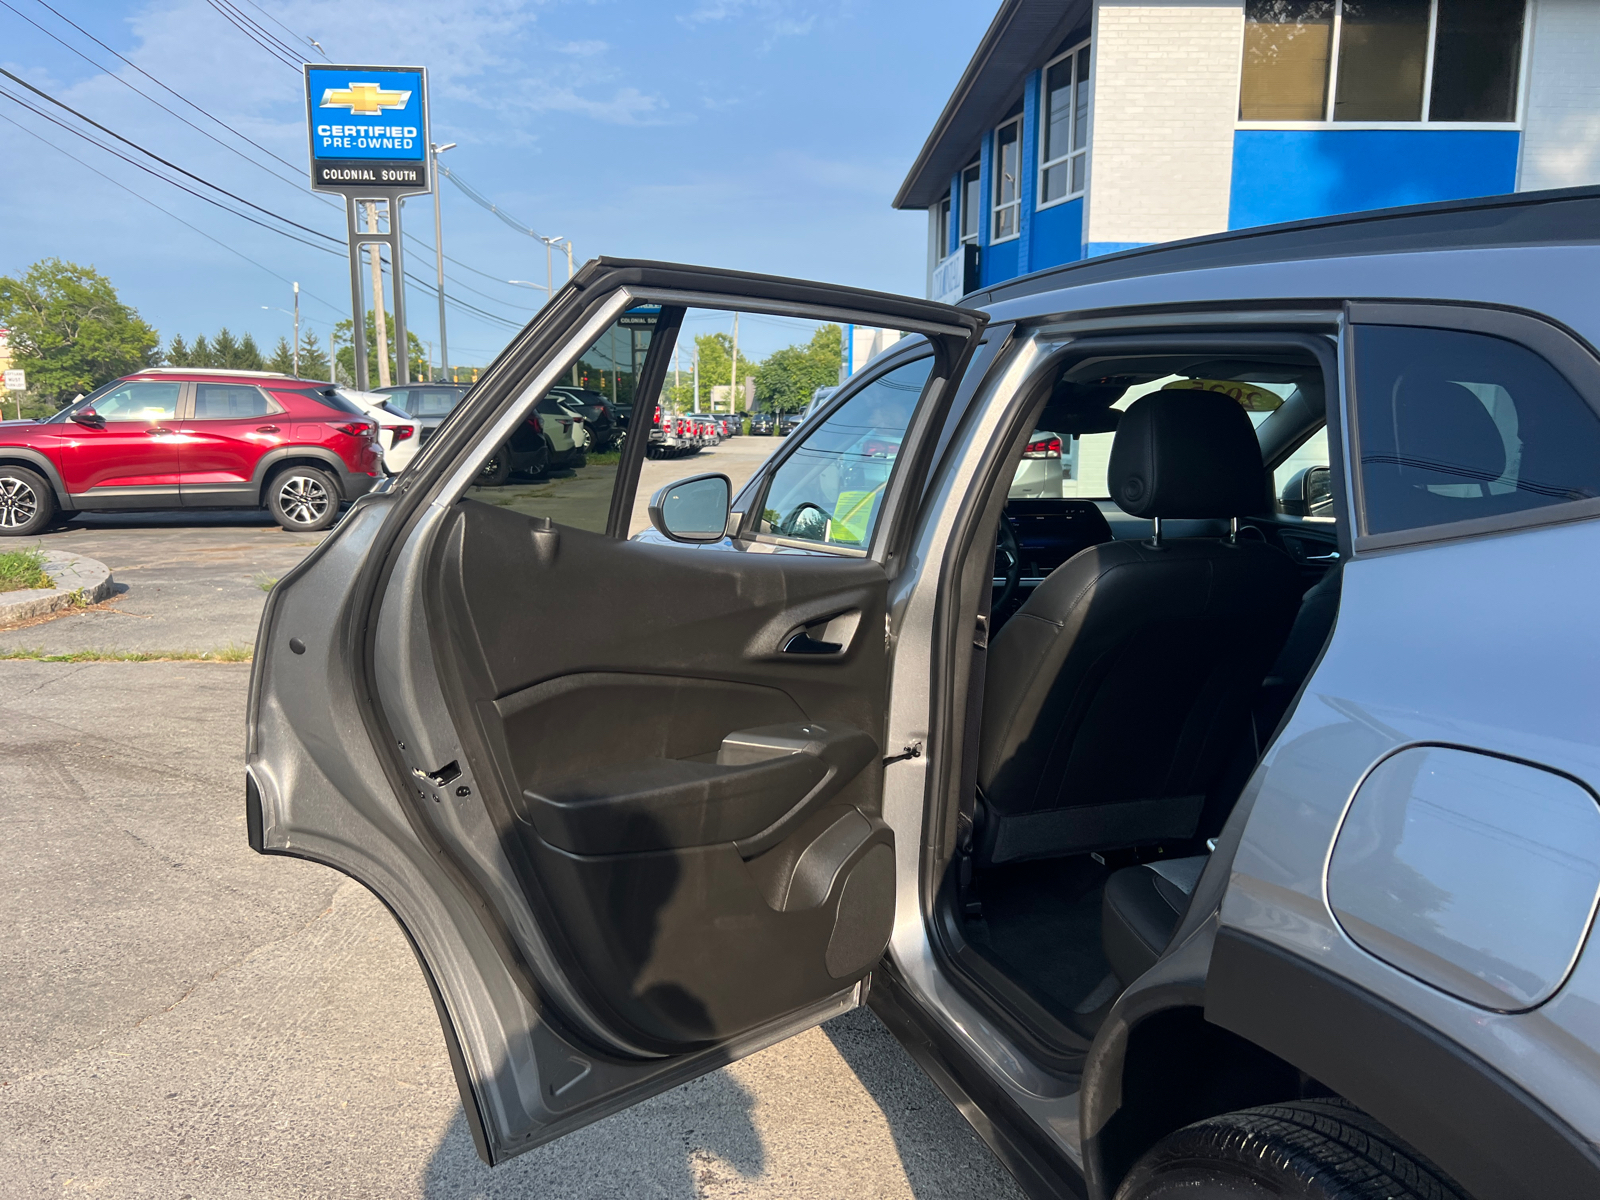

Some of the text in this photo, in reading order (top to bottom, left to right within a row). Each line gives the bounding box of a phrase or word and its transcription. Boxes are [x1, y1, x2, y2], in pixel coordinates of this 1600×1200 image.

[317, 125, 417, 138] CERTIFIED
[323, 137, 413, 149] PRE-OWNED
[322, 169, 417, 181] COLONIAL SOUTH
